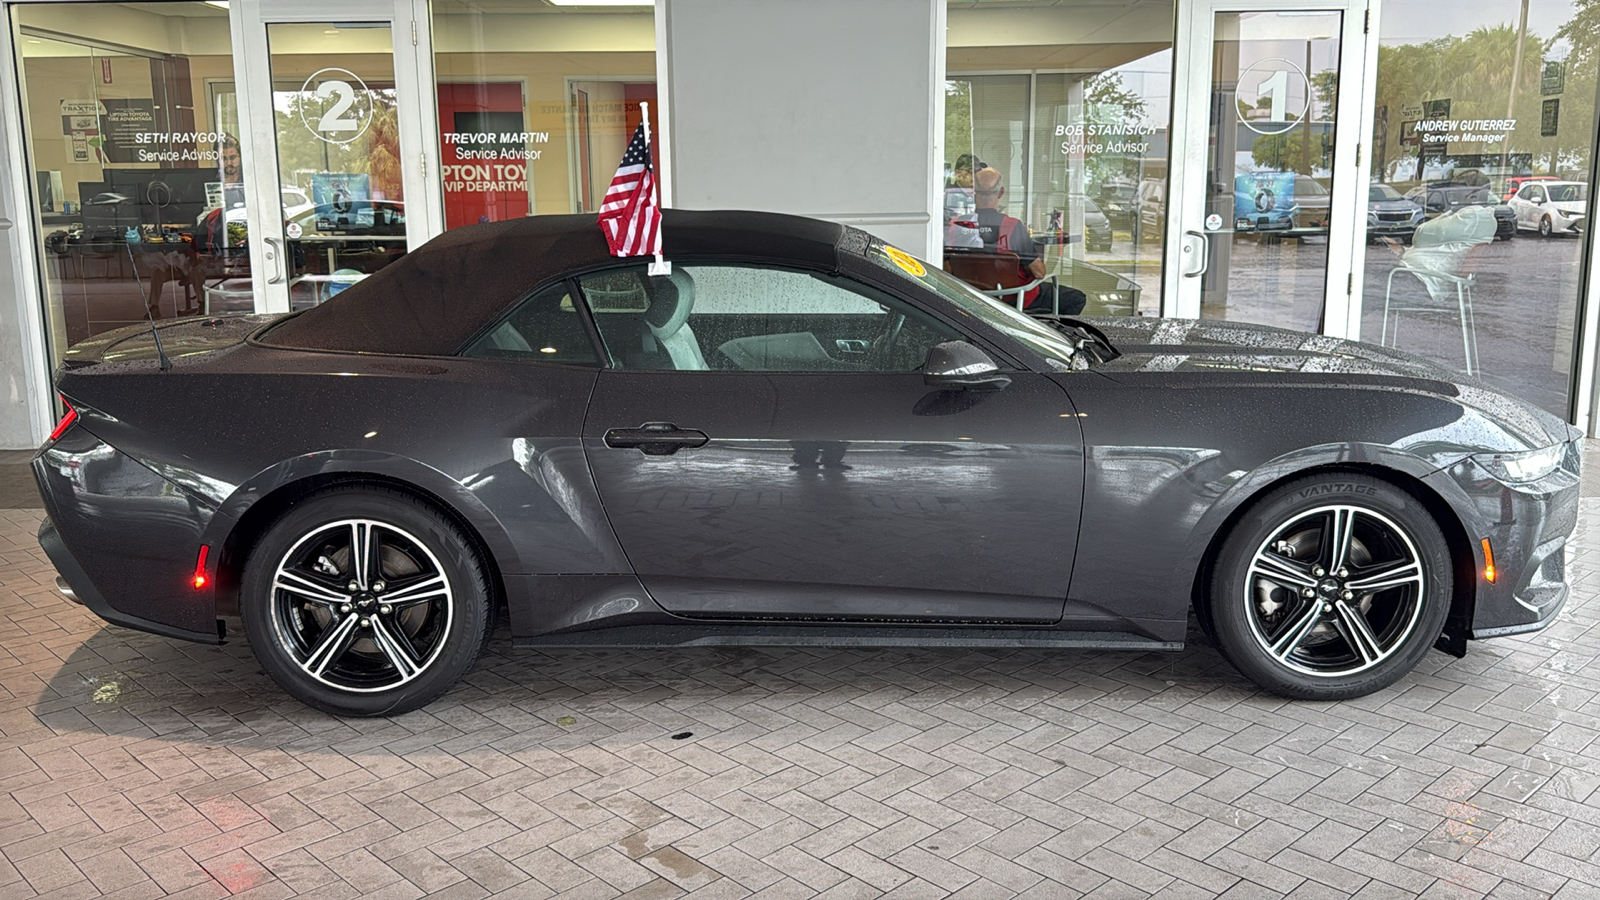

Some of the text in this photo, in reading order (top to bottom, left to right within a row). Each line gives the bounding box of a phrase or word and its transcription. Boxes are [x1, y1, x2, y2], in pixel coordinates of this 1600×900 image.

[1258, 70, 1288, 122] 1
[316, 80, 358, 131] 2
[1055, 124, 1157, 136] BOB STANISICH
[1414, 119, 1517, 132] ANDREW GUTIERREZ
[135, 132, 227, 143] SETH RAYGOR
[443, 132, 549, 144] TREVOR MARTIN
[1422, 132, 1506, 144] Service Manager
[455, 147, 542, 160] Service Advisor
[1061, 139, 1149, 155] Service Advisor
[138, 147, 224, 161] Service Advisor
[444, 181, 464, 192] VIP
[1299, 483, 1378, 499] VANTAGE
